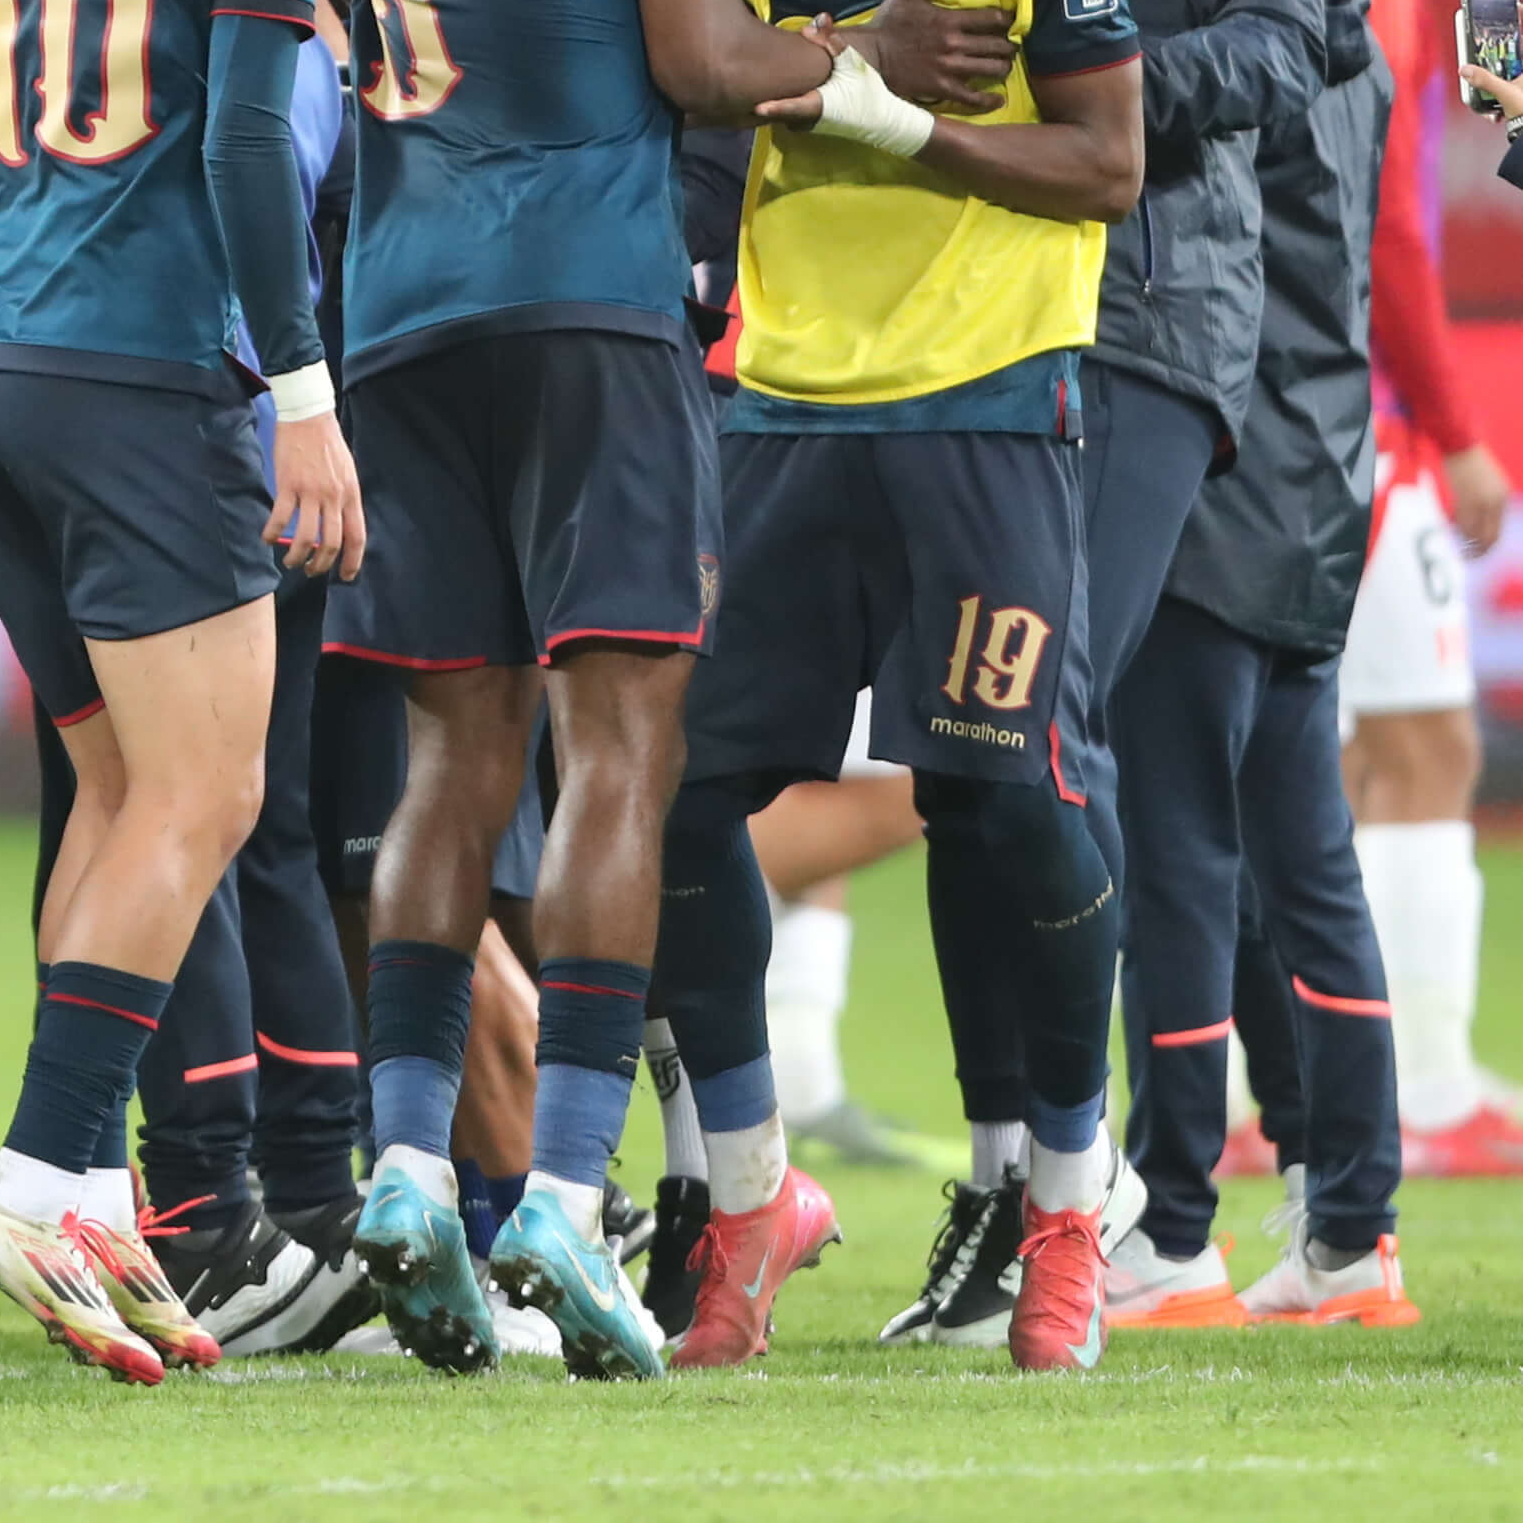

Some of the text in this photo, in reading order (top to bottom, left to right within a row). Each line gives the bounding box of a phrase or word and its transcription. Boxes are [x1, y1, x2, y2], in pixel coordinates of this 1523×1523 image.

[940, 594, 1053, 712] 19
[930, 713, 1026, 750] marathon
[343, 836, 382, 854] mara
